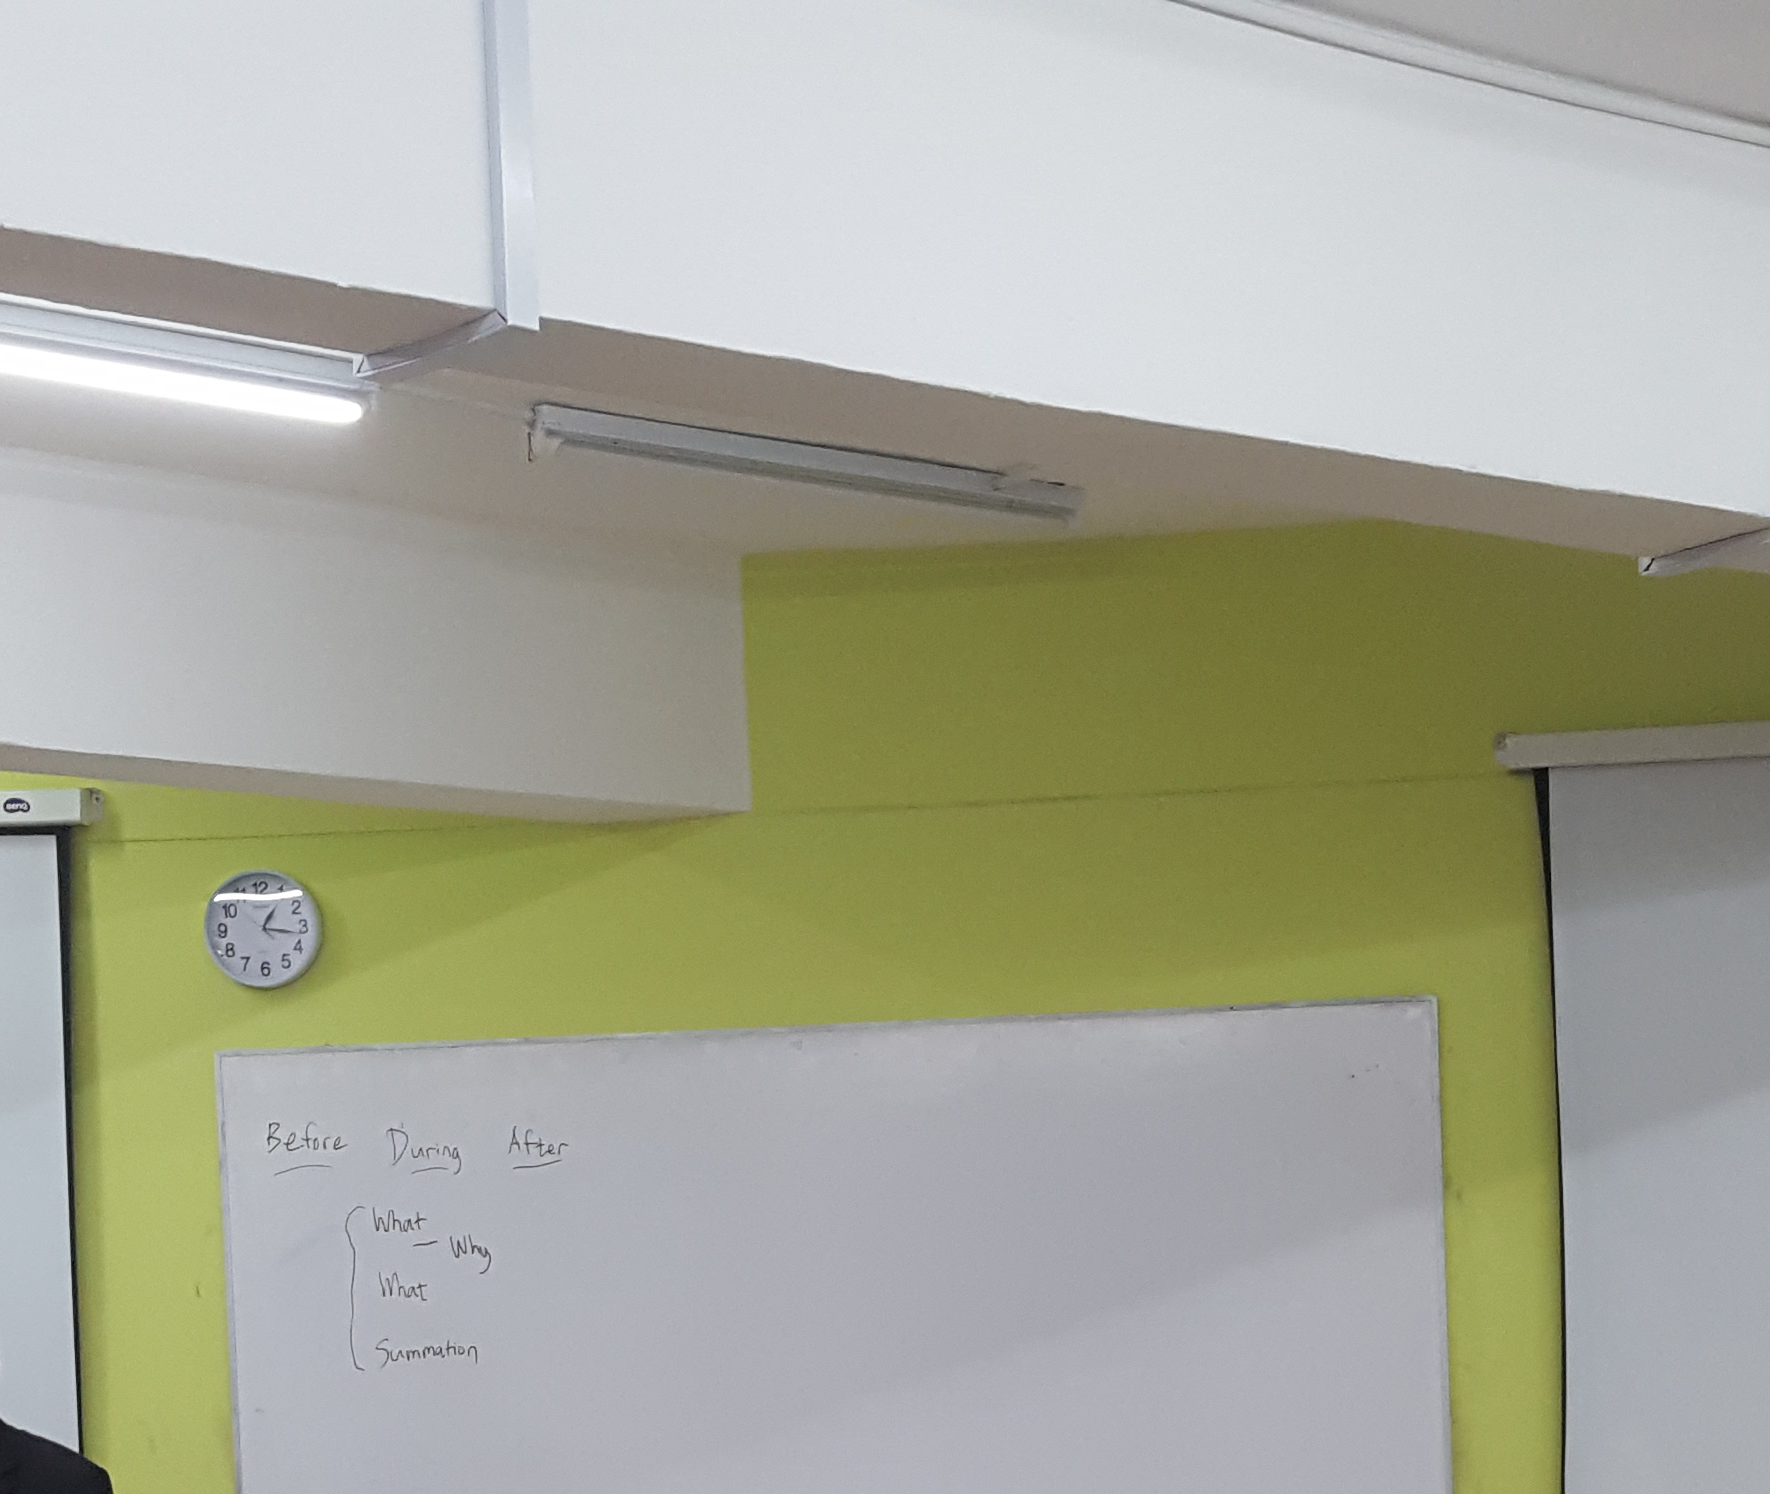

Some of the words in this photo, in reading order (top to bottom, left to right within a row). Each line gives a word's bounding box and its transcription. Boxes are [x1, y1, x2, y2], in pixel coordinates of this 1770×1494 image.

[252, 881, 269, 894] 12
[222, 903, 237, 919] 10
[291, 900, 302, 915] 2
[217, 923, 228, 939] 9
[298, 919, 309, 934] 3
[225, 943, 236, 958] 8
[293, 939, 304, 954] 4
[240, 956, 251, 972] 7
[260, 961, 271, 977] 6
[281, 953, 292, 969] 5
[265, 1122, 349, 1155] Before
[386, 1125, 463, 1175] During
[507, 1125, 570, 1157] After
[373, 1207, 428, 1233] What
[449, 1235, 492, 1275] Why
[378, 1271, 428, 1302] What
[375, 1338, 479, 1369] Summation
